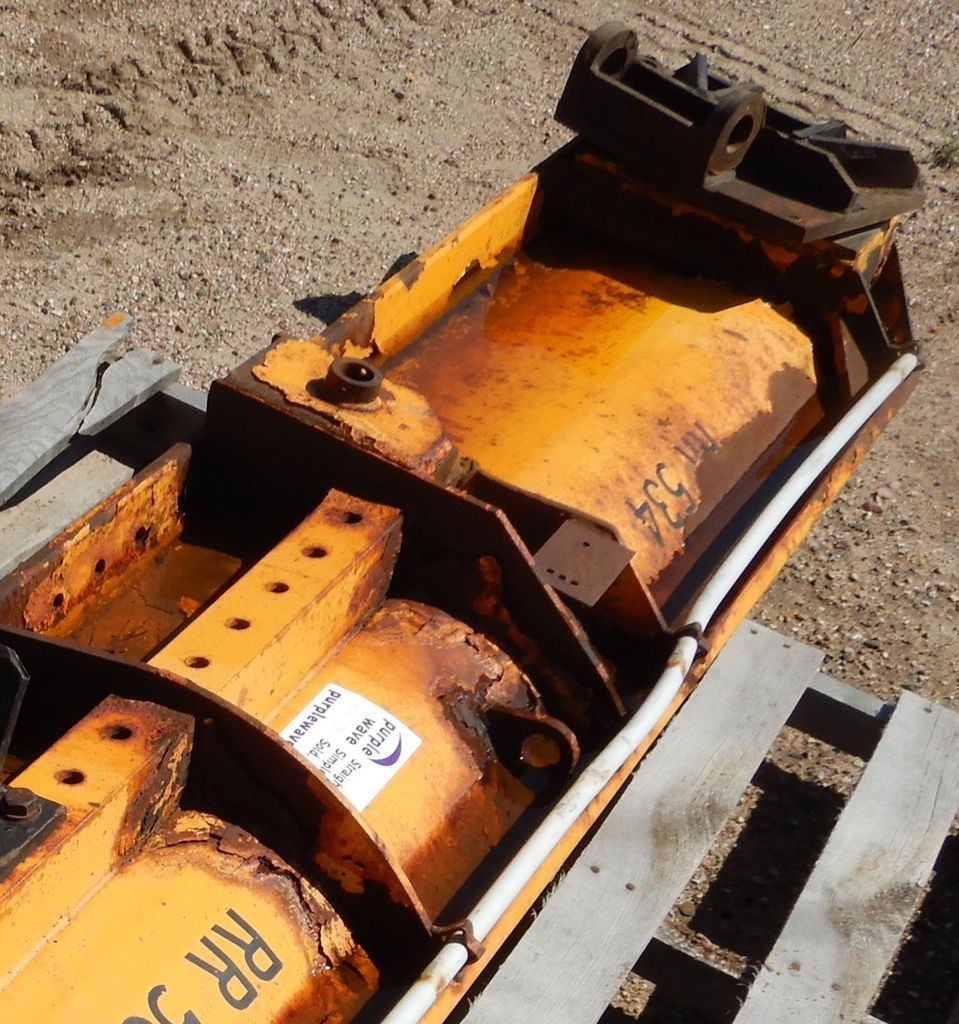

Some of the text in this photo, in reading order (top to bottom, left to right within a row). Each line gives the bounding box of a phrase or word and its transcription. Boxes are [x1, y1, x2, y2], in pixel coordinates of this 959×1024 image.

[624, 462, 697, 548] 534
[307, 738, 331, 759] Sold.
[345, 717, 376, 746] wave
[361, 718, 396, 757] purple
[184, 908, 283, 1011] RR
